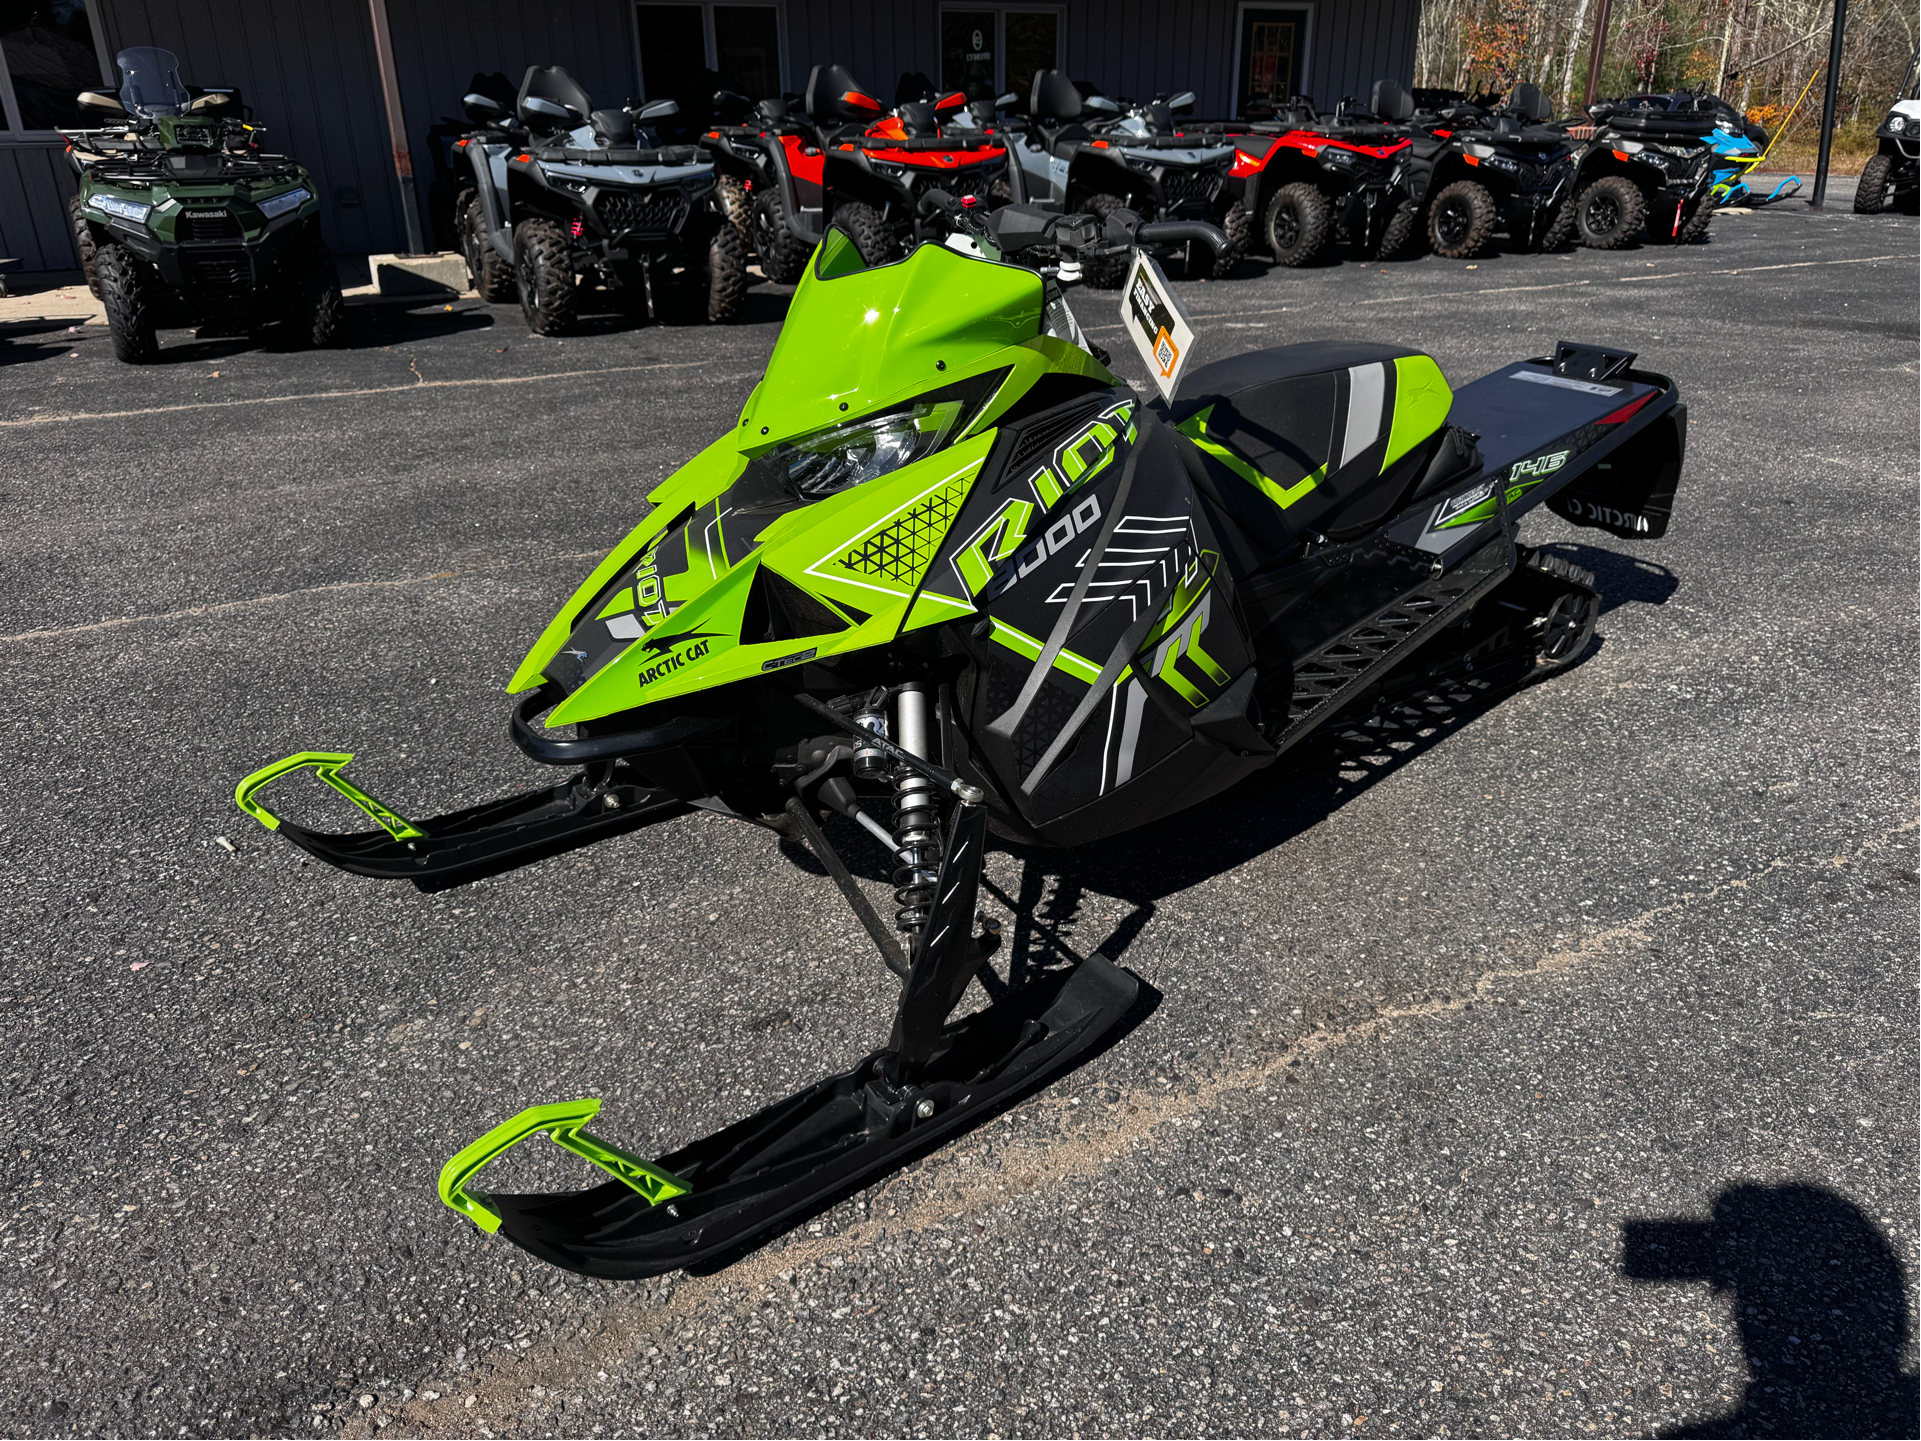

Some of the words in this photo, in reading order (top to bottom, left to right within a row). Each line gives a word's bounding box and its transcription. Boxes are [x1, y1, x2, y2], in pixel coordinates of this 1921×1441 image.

[185, 210, 227, 219] Kawasaki
[1133, 290, 1158, 335] FINANCING
[1135, 278, 1156, 314] EASY
[1509, 450, 1571, 482] 146
[949, 399, 1138, 608] RIOT
[986, 494, 1102, 602] 8000
[638, 653, 685, 688] ARCTIC
[686, 639, 710, 662] CAT
